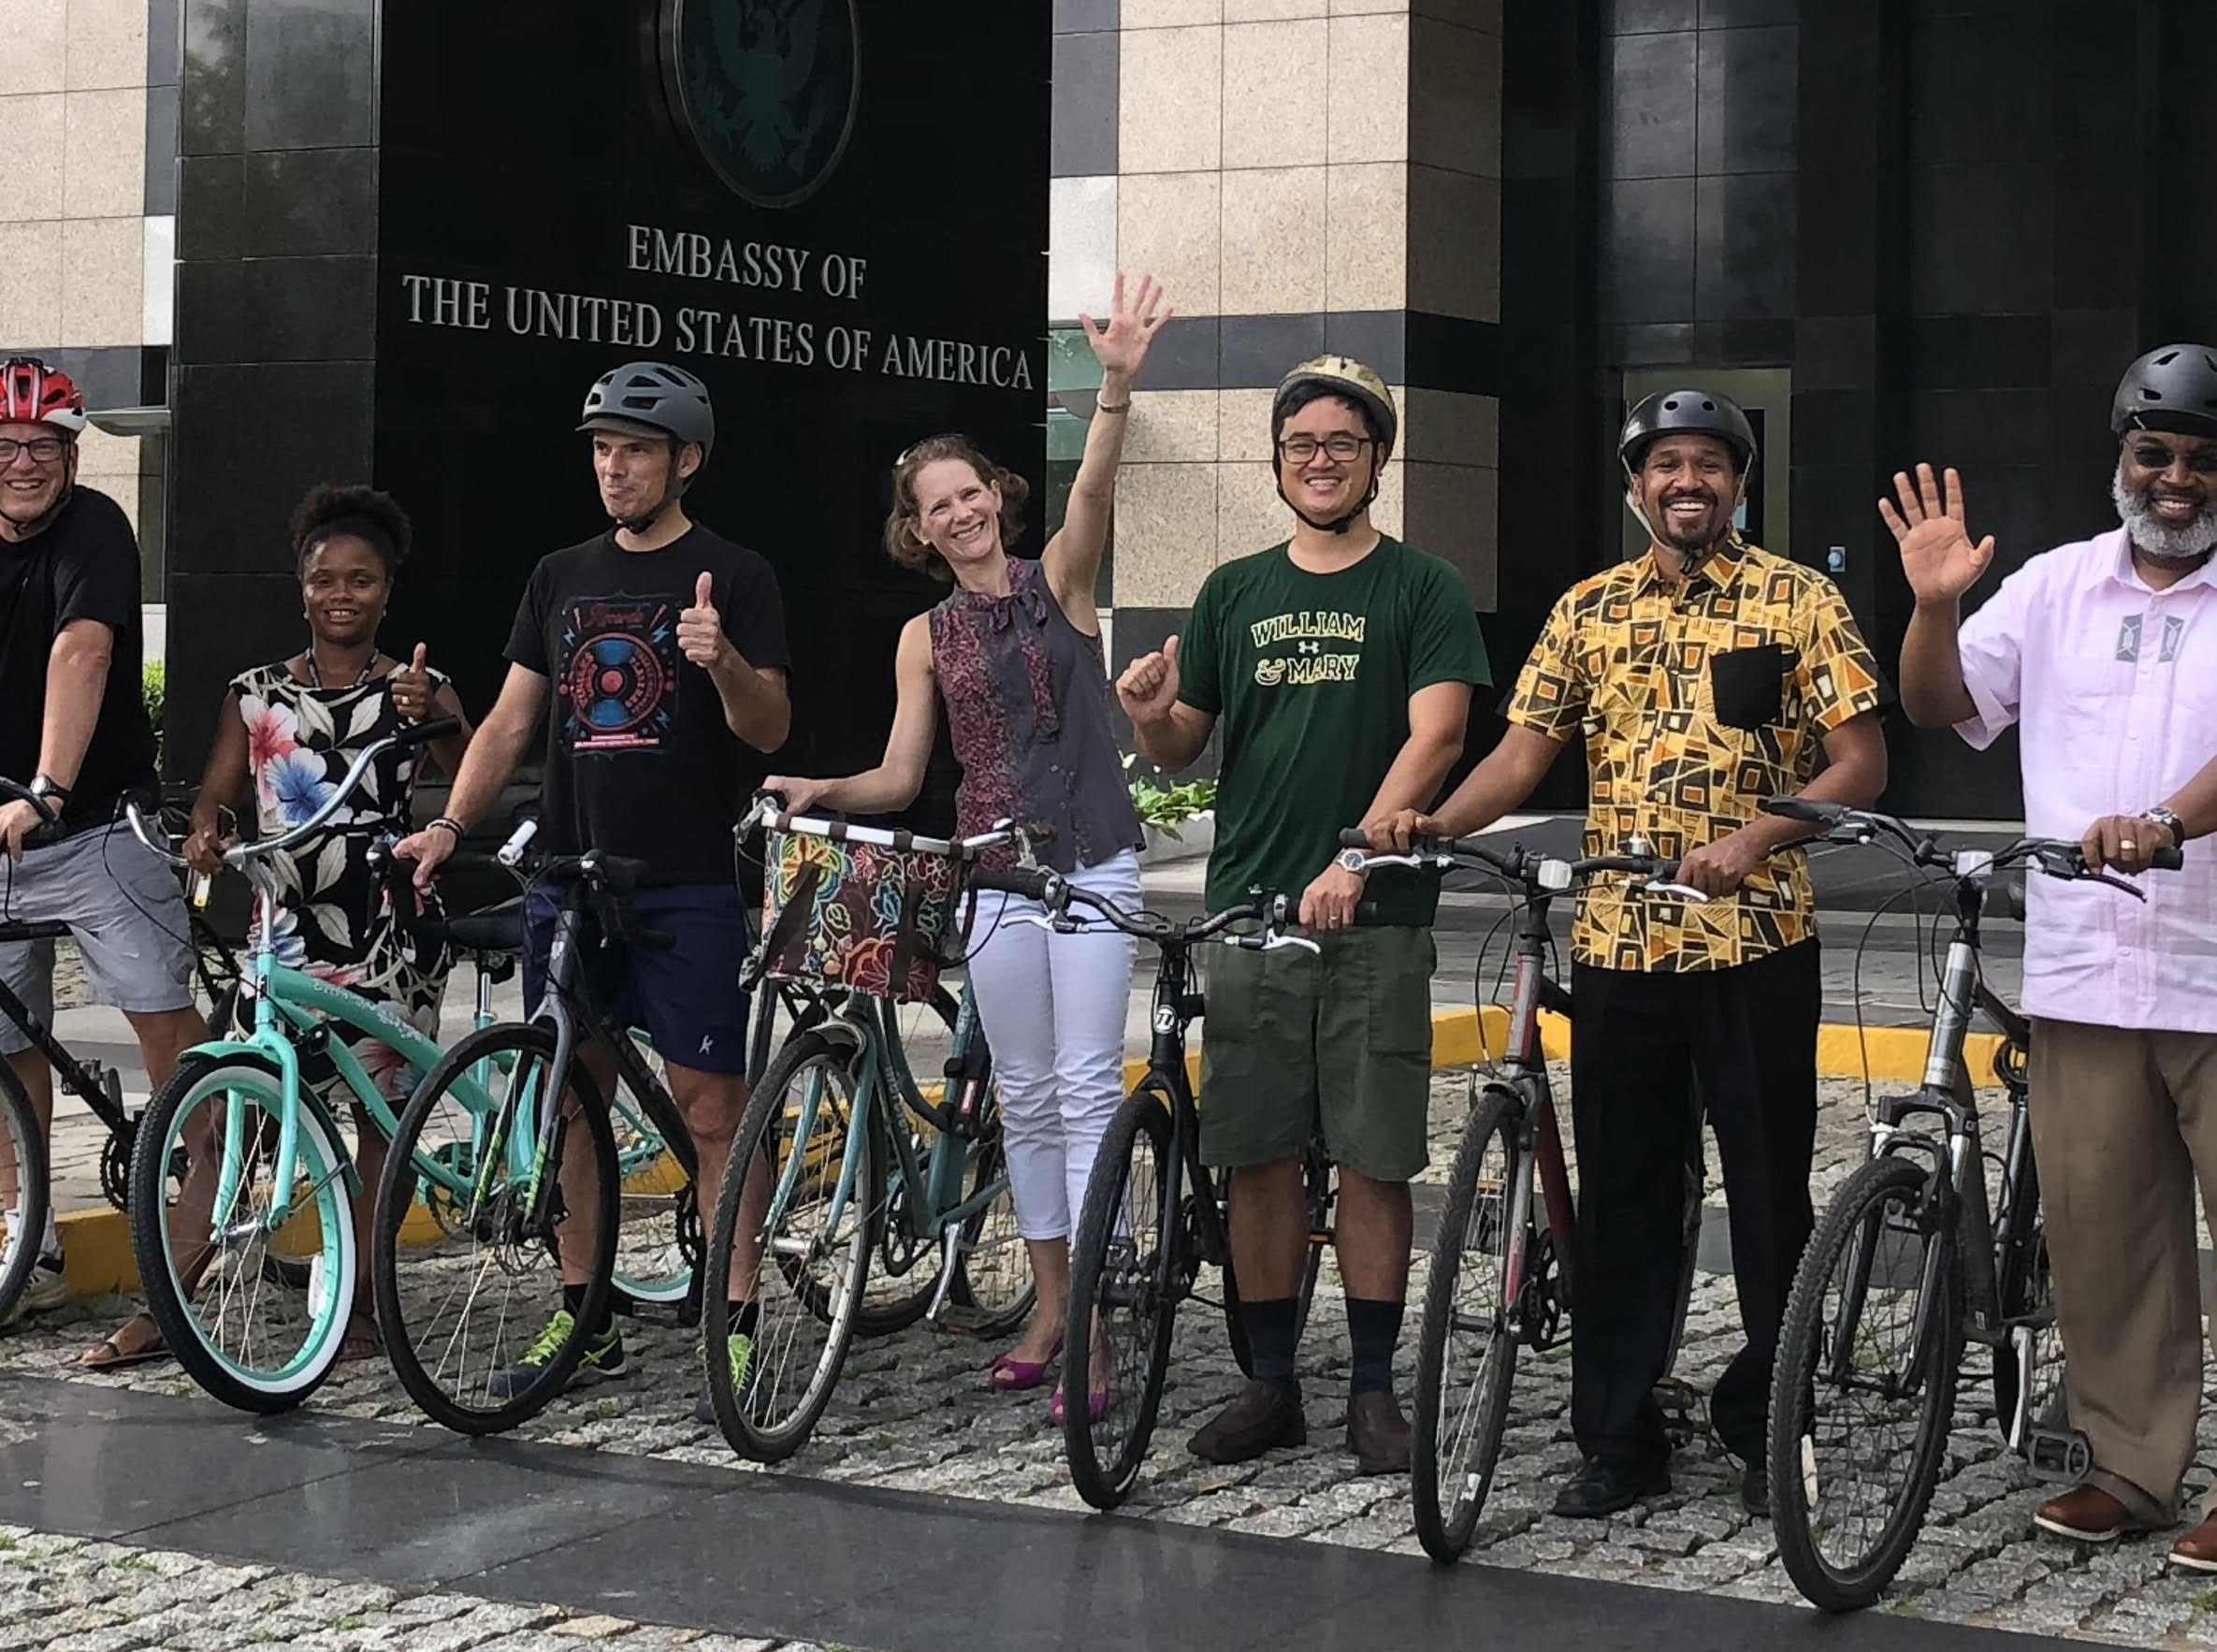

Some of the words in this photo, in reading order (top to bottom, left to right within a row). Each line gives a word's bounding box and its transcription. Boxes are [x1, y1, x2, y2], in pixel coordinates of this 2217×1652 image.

[626, 225, 811, 293] EMBASSY
[821, 254, 867, 299] OF
[401, 274, 491, 329] THE
[504, 286, 661, 348] UNITED
[675, 307, 814, 366] STATES
[825, 326, 871, 371] OF
[881, 333, 1034, 390] AMERICA
[1251, 611, 1366, 648] WILLIAM
[1287, 654, 1360, 685] MARY
